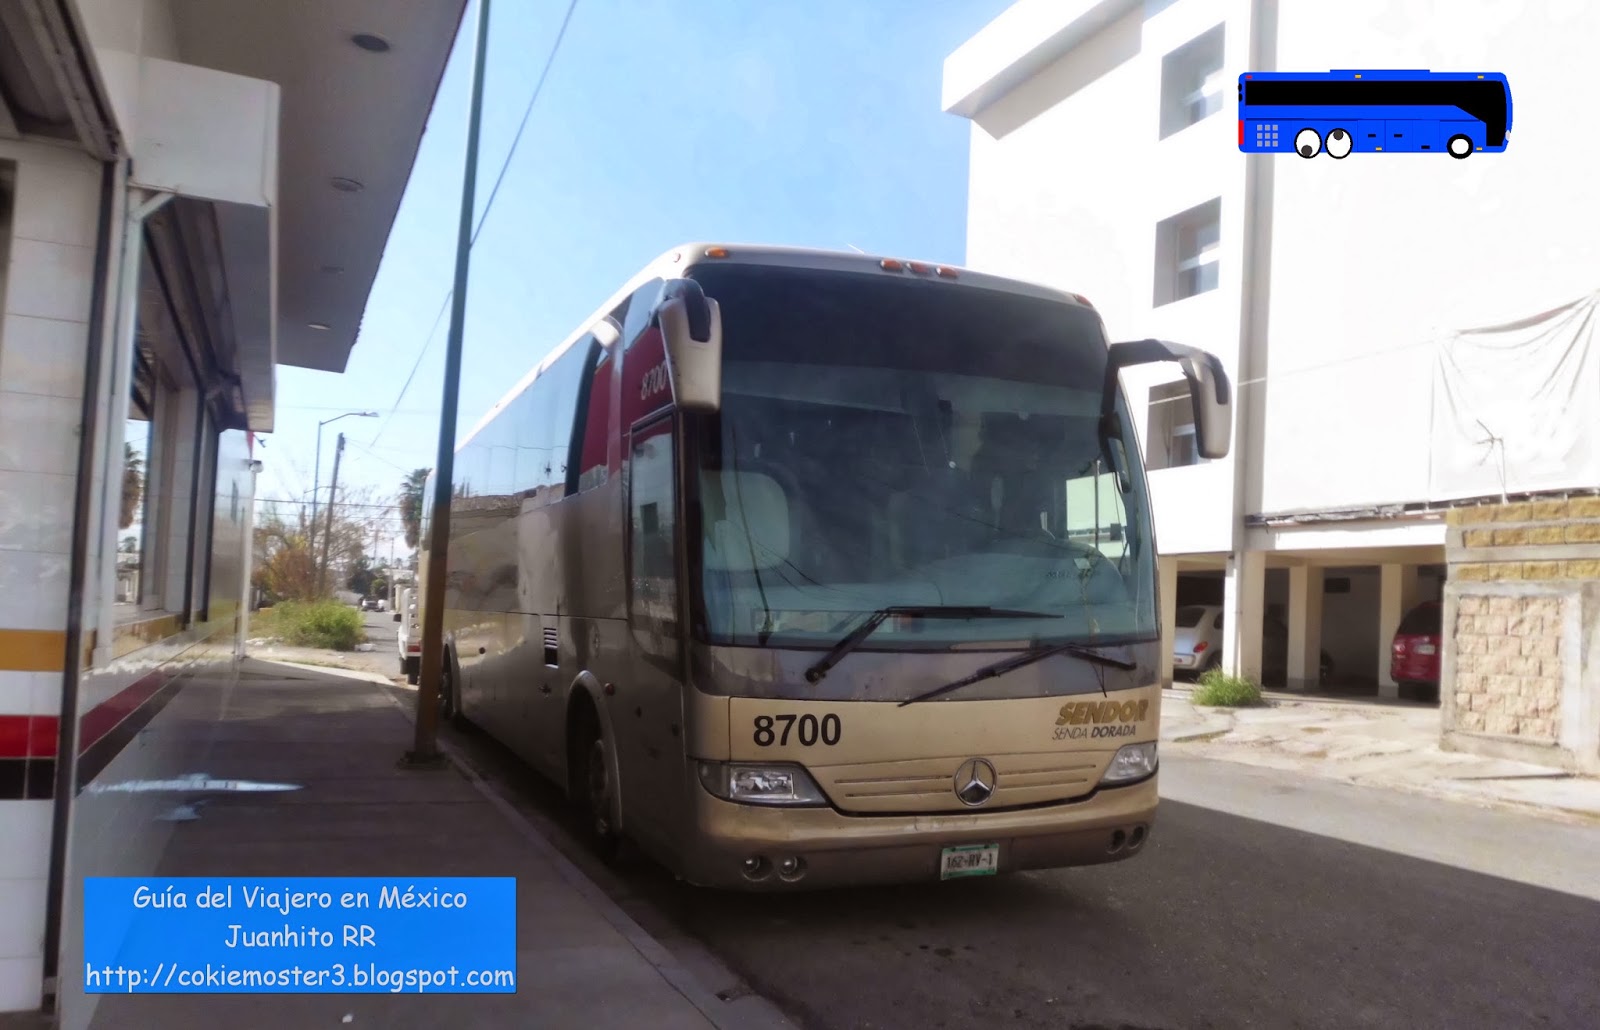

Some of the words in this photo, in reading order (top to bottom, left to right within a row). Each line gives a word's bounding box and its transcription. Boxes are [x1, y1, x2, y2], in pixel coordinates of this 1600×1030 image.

[641, 359, 668, 400] 8700
[1055, 699, 1149, 726] SENDOR
[753, 713, 842, 747] 8700
[1052, 727, 1088, 740] SENDA
[1091, 725, 1137, 738] DORADA
